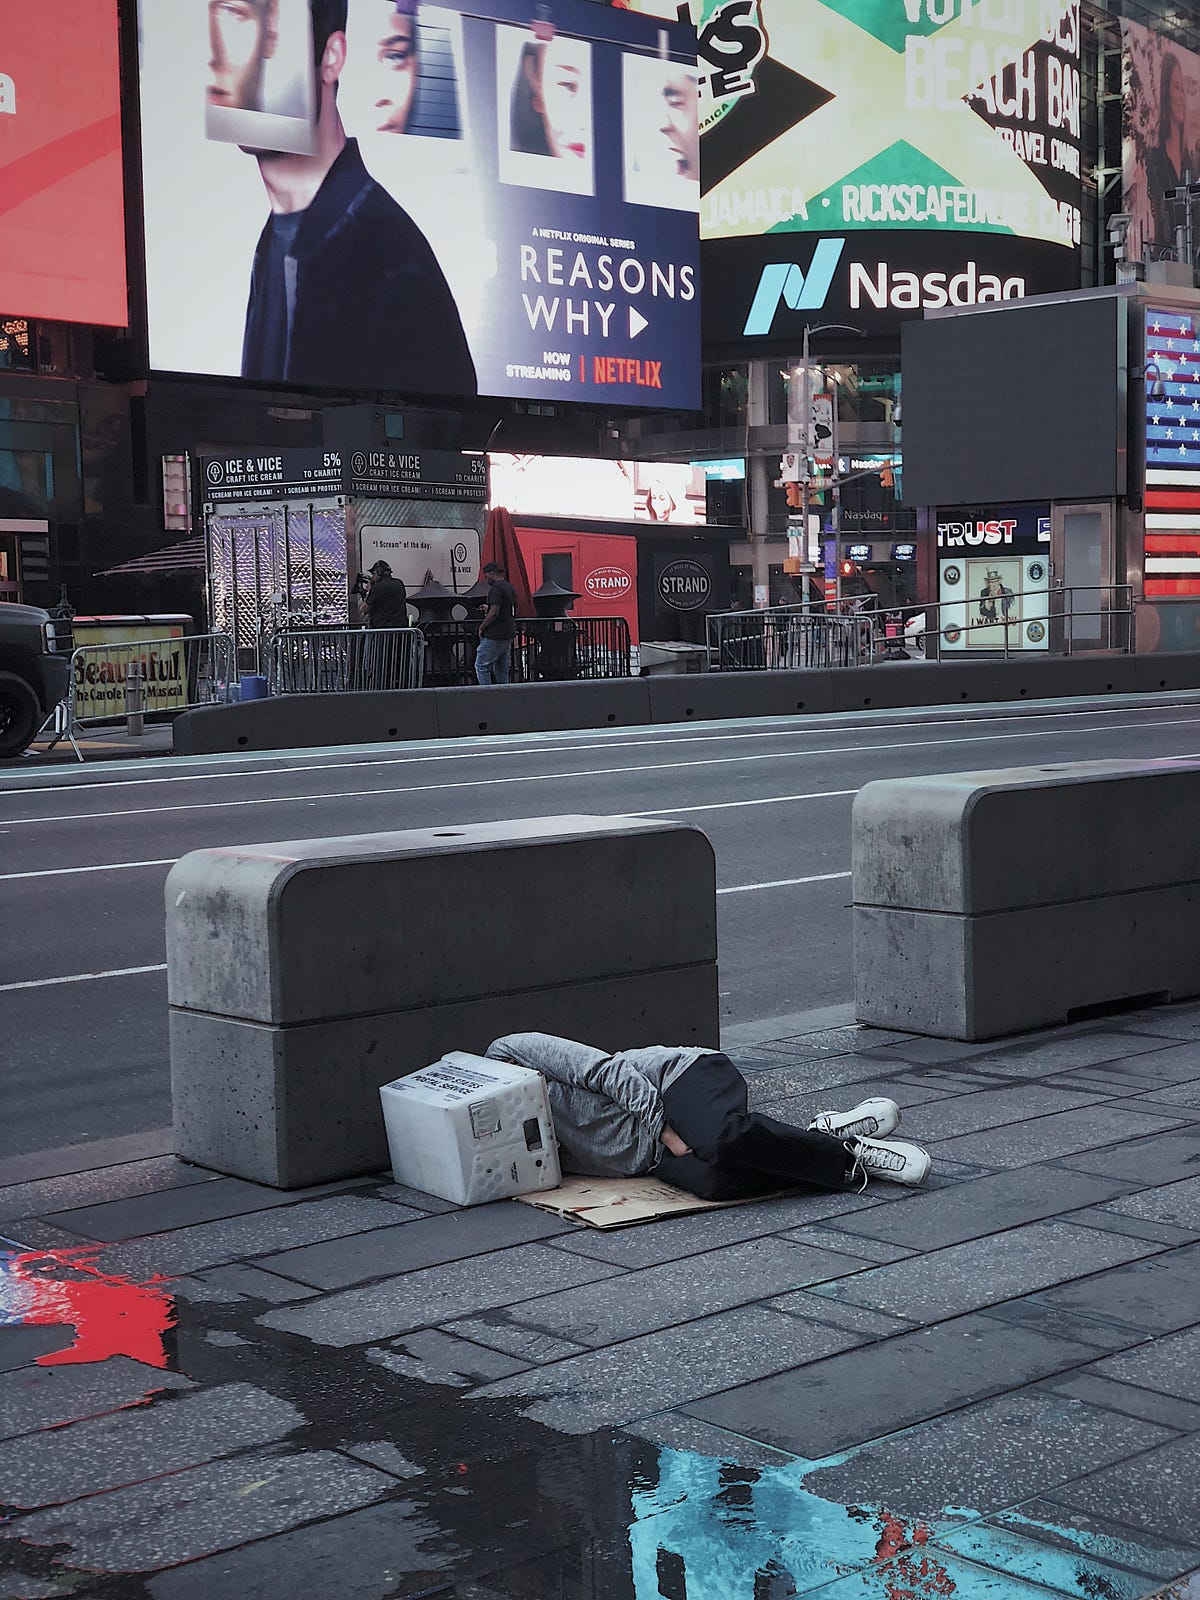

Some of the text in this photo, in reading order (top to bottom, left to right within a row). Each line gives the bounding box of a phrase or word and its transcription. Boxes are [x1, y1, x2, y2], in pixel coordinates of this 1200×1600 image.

[905, 34, 1036, 122] BEACH
[703, 186, 809, 229] JAMAICA
[532, 228, 635, 250] A NETFLIX ORIGINAL SERIES
[520, 244, 695, 301] REASONS
[522, 293, 616, 338] WHY
[543, 351, 571, 365] NOW
[506, 364, 571, 381] STREAMING
[593, 355, 662, 389] NETFLIX
[225, 456, 282, 474] ICE & VICE
[323, 452, 341, 467] 5%
[369, 452, 420, 469] ICE & VICE
[471, 460, 486, 474] 5%
[851, 459, 886, 469] Nasda
[225, 472, 283, 483] CRAFT ICE CREAM
[303, 468, 342, 478] TO CHARITY
[369, 468, 421, 479] CRAFT ICE CREAM
[463, 474, 486, 483] CHARITY
[211, 490, 232, 499] SCREAM
[243, 489, 252, 497] ICE
[287, 486, 309, 494] SCREAM
[355, 483, 378, 491] SCREAM
[379, 484, 390, 492] FOR
[391, 485, 400, 493] ICE
[435, 488, 455, 496] SCREAM
[844, 510, 883, 521] Nasdaq
[937, 519, 1018, 547] TRUST
[588, 576, 629, 589] STRAND
[662, 577, 708, 594] STRAND
[75, 651, 181, 685] Beauiful
[77, 688, 89, 702] he
